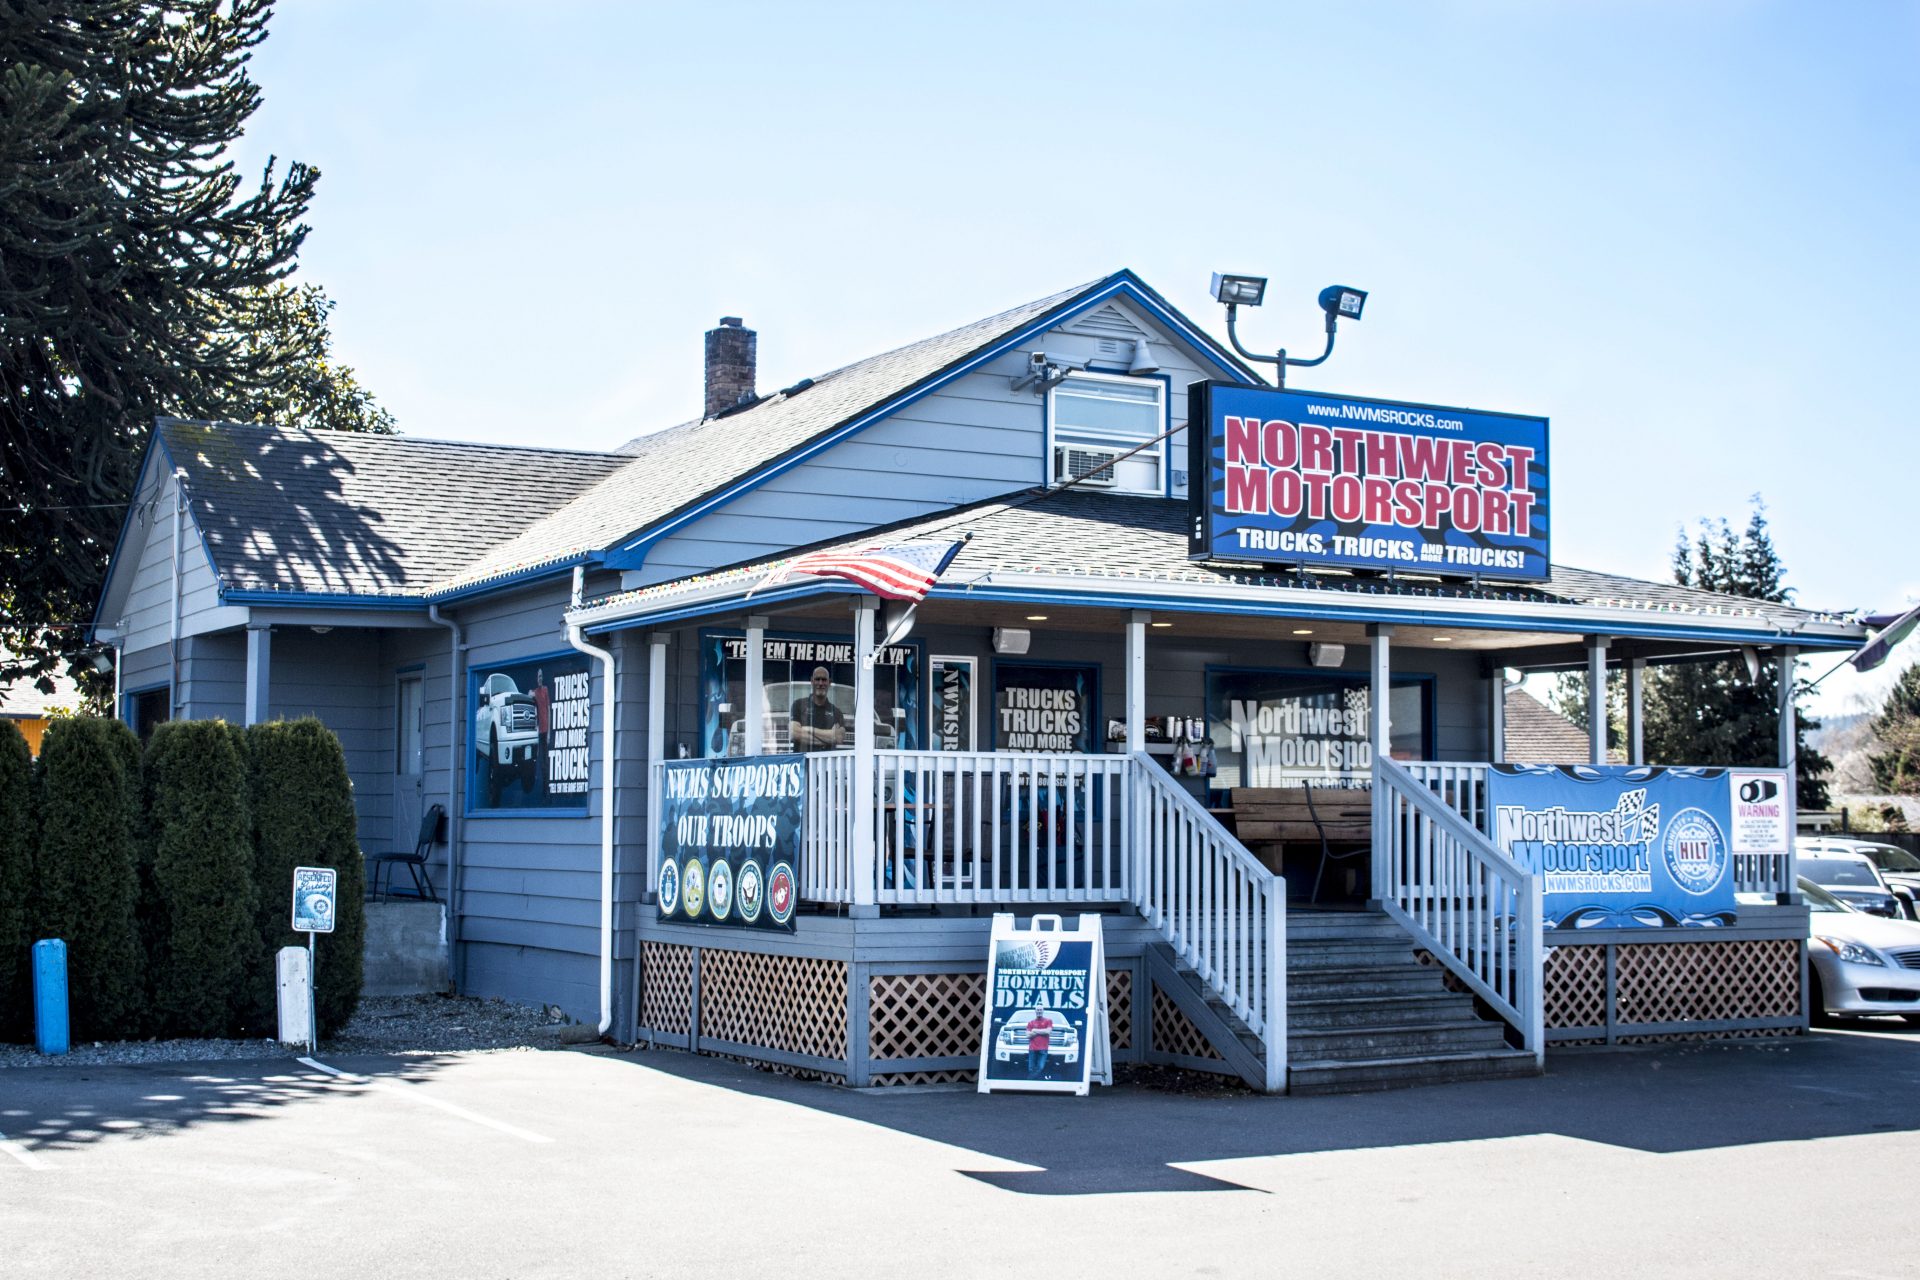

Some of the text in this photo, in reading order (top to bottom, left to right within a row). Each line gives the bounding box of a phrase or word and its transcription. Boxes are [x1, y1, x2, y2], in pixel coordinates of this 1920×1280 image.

[1307, 404, 1463, 431] www.NWMSROCKS.com
[1225, 415, 1535, 491] NORTHWEST
[1225, 464, 1536, 537] MOTORSPORT
[1237, 528, 1525, 569] TRUCKS, TRUCKS, AND TRUCKS!
[789, 644, 814, 661] THE
[816, 645, 851, 663] BONE
[554, 672, 589, 701] TRUCKS
[1005, 687, 1076, 711] TRUCKS
[551, 698, 590, 730] TRUCKS
[1000, 708, 1081, 735] TRUCKS
[1231, 699, 1366, 752] Northwest
[554, 728, 587, 748] AND MORE
[1008, 733, 1073, 750] AND MORE
[1247, 735, 1372, 788] Motorspo
[666, 763, 801, 800] NWMS SUPPORTS
[1738, 804, 1780, 818] WARNING
[677, 815, 777, 848] OUR TROOPS
[1496, 805, 1624, 858] Northwest
[1512, 840, 1649, 876] Motorsport
[1680, 841, 1708, 860] HILT
[996, 975, 1086, 990] HOMERUN
[998, 968, 1039, 976] NORTHWEST
[995, 989, 1085, 1009] DEALS
